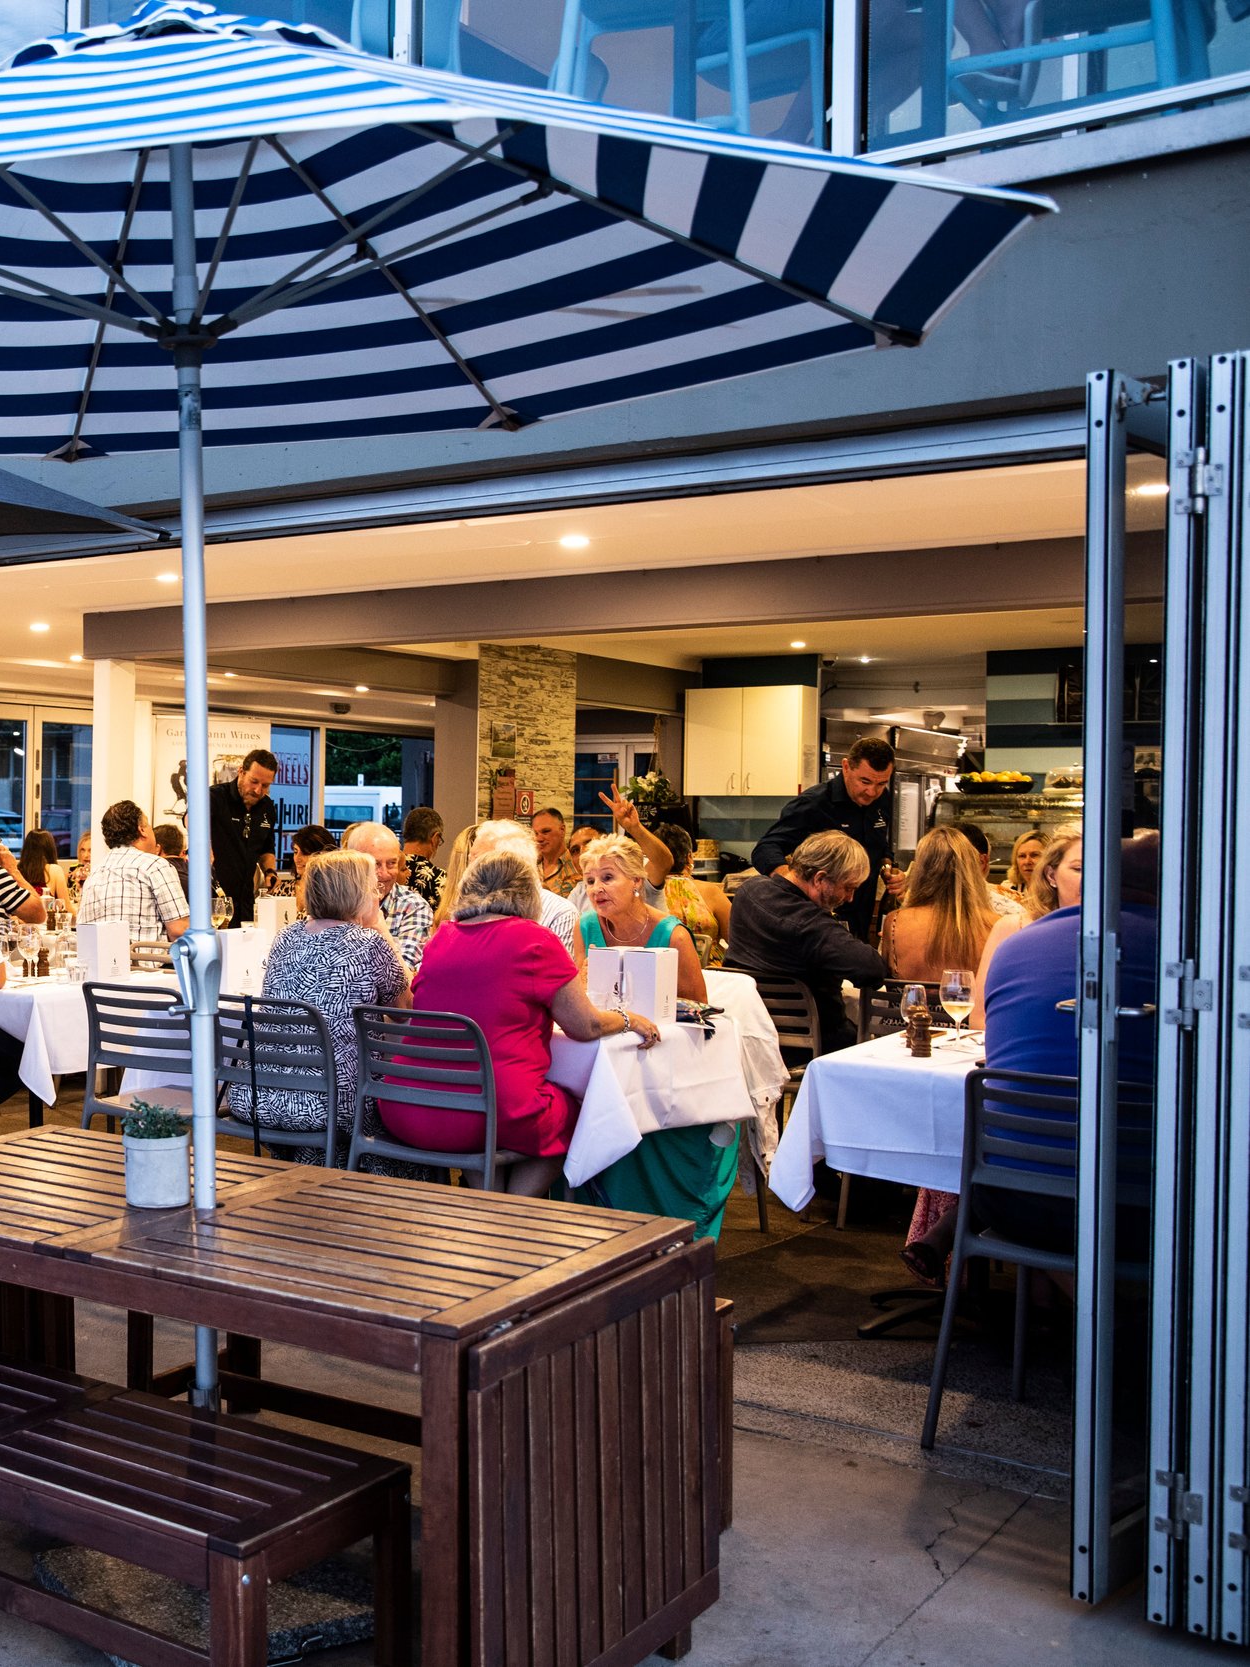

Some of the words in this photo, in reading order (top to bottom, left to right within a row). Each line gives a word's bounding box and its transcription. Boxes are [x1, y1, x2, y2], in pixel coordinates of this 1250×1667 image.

[166, 728, 226, 739] Garann
[231, 731, 261, 740] Wines
[273, 751, 309, 784] HEELS
